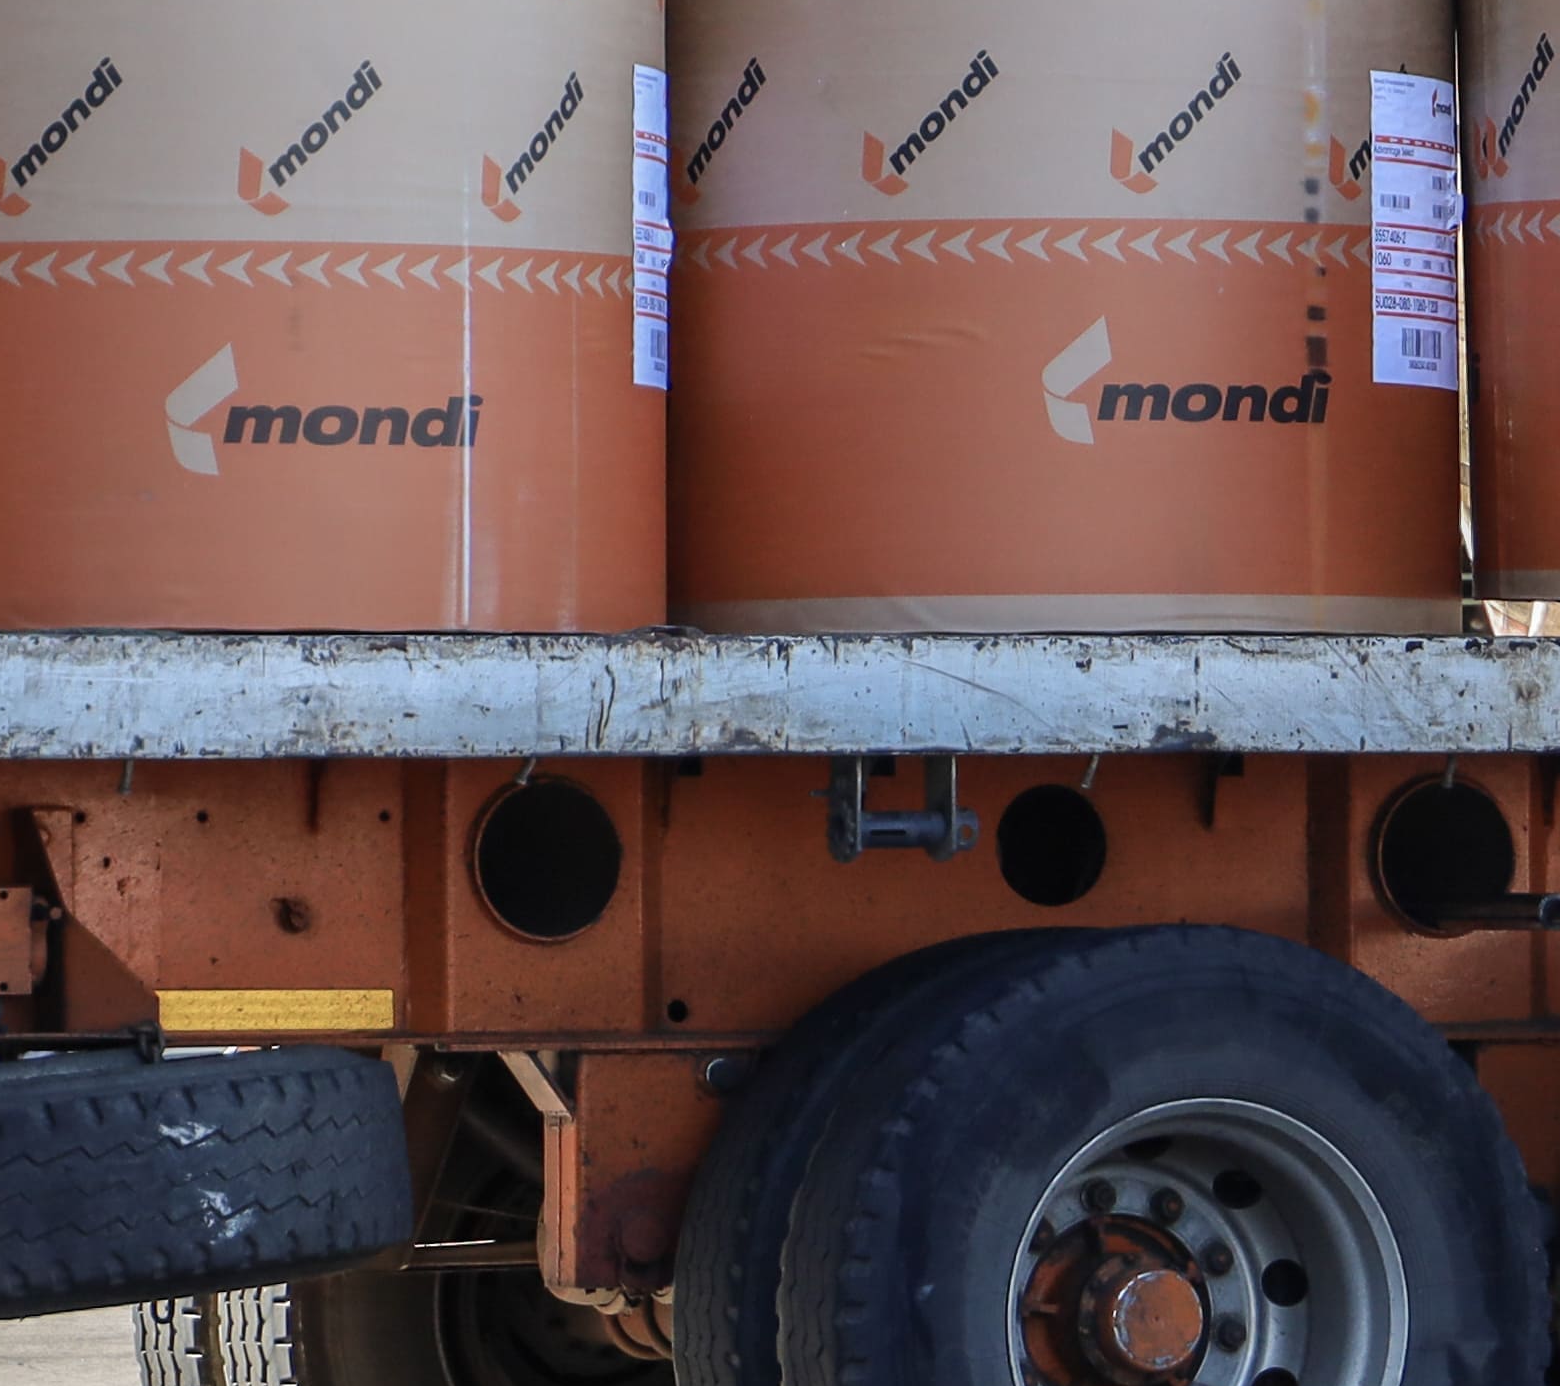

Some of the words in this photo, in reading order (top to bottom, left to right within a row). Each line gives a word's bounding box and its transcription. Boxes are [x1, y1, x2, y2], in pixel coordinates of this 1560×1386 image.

[11, 58, 122, 187] mondi
[269, 61, 382, 187] mondi
[506, 72, 583, 194] mondi
[687, 57, 768, 184] mondi
[890, 50, 998, 175] mondi
[1135, 51, 1241, 174] mondi
[1497, 33, 1554, 156] mondi
[223, 395, 483, 447] mondi
[1097, 369, 1332, 425] mondi
